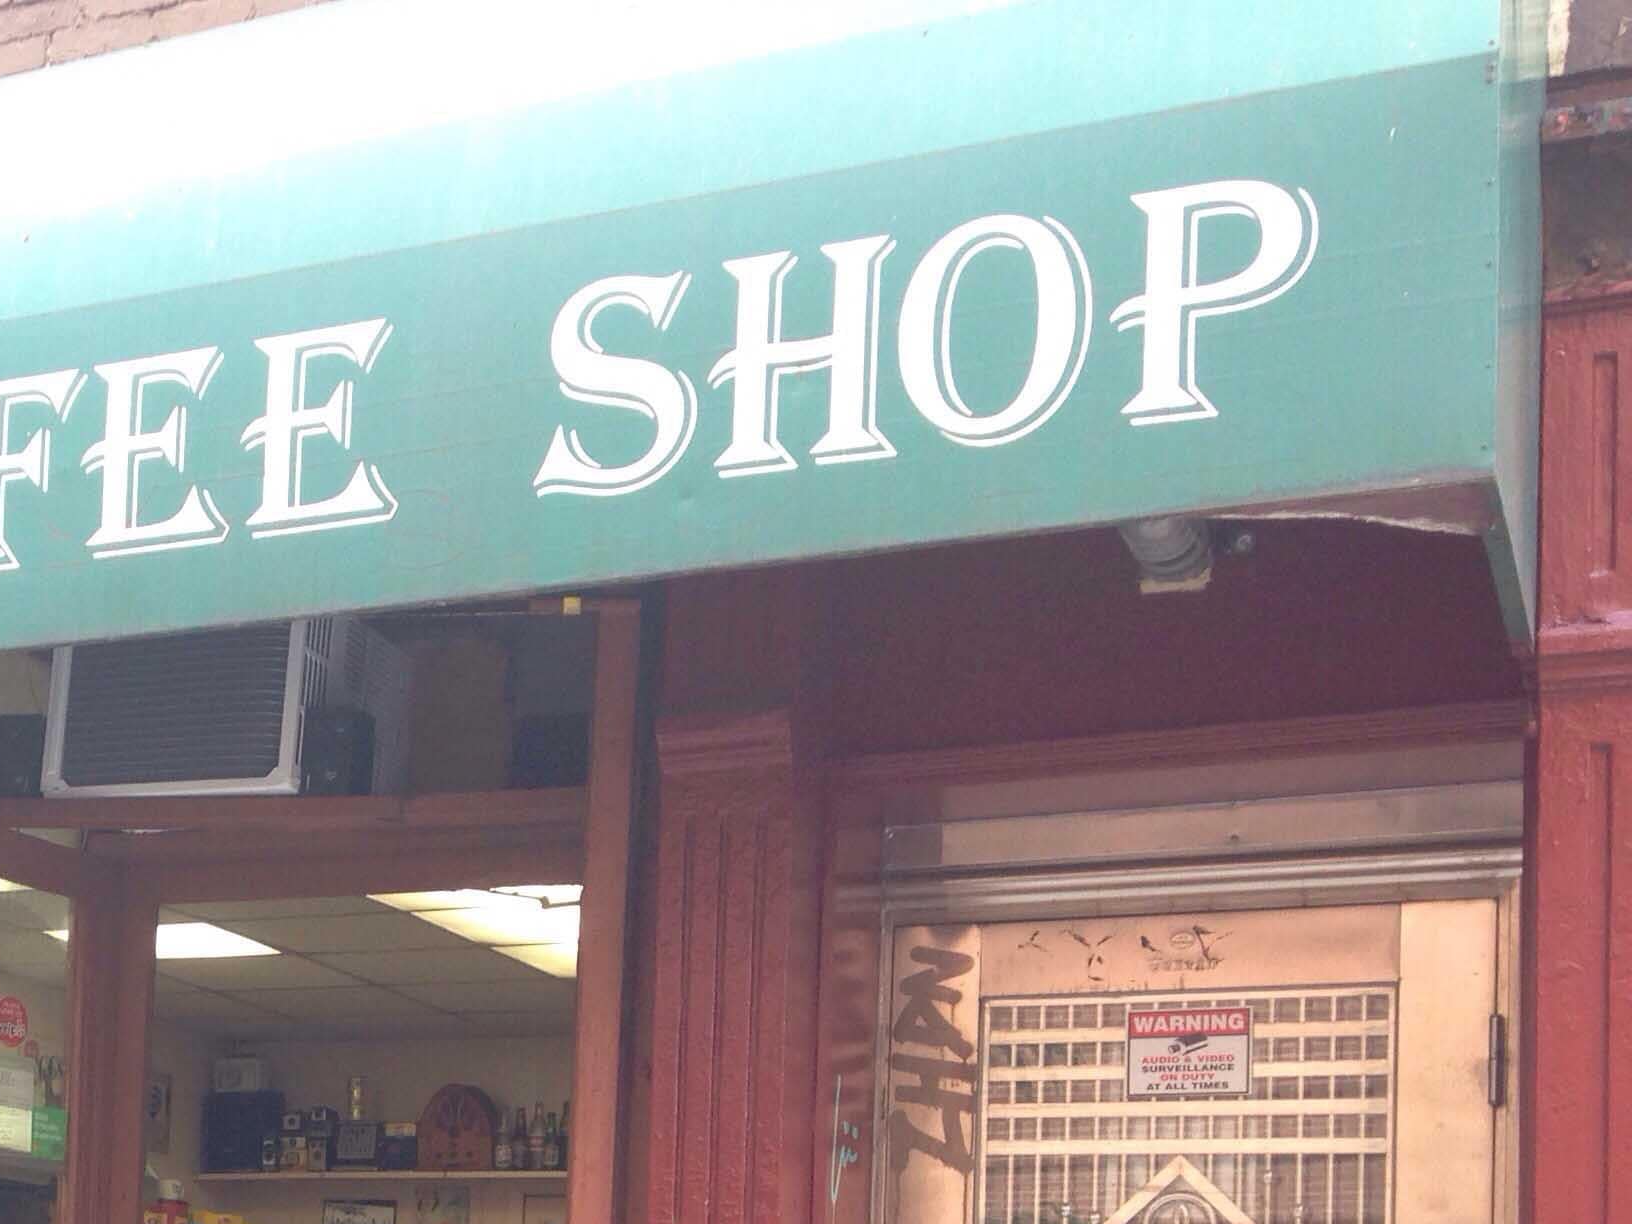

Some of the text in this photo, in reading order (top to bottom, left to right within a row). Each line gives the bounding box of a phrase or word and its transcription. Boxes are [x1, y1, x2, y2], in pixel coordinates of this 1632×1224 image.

[533, 179, 1319, 498] SHOP
[1133, 1013, 1244, 1033] WARNING
[1142, 1056, 1180, 1064] AUDIO
[1197, 1054, 1235, 1063] VIDEO
[1141, 1063, 1235, 1073] SURVEILLANCE
[1160, 1072, 1215, 1081] ON DUTY
[1146, 1081, 1229, 1091] AT ALL TIMES
